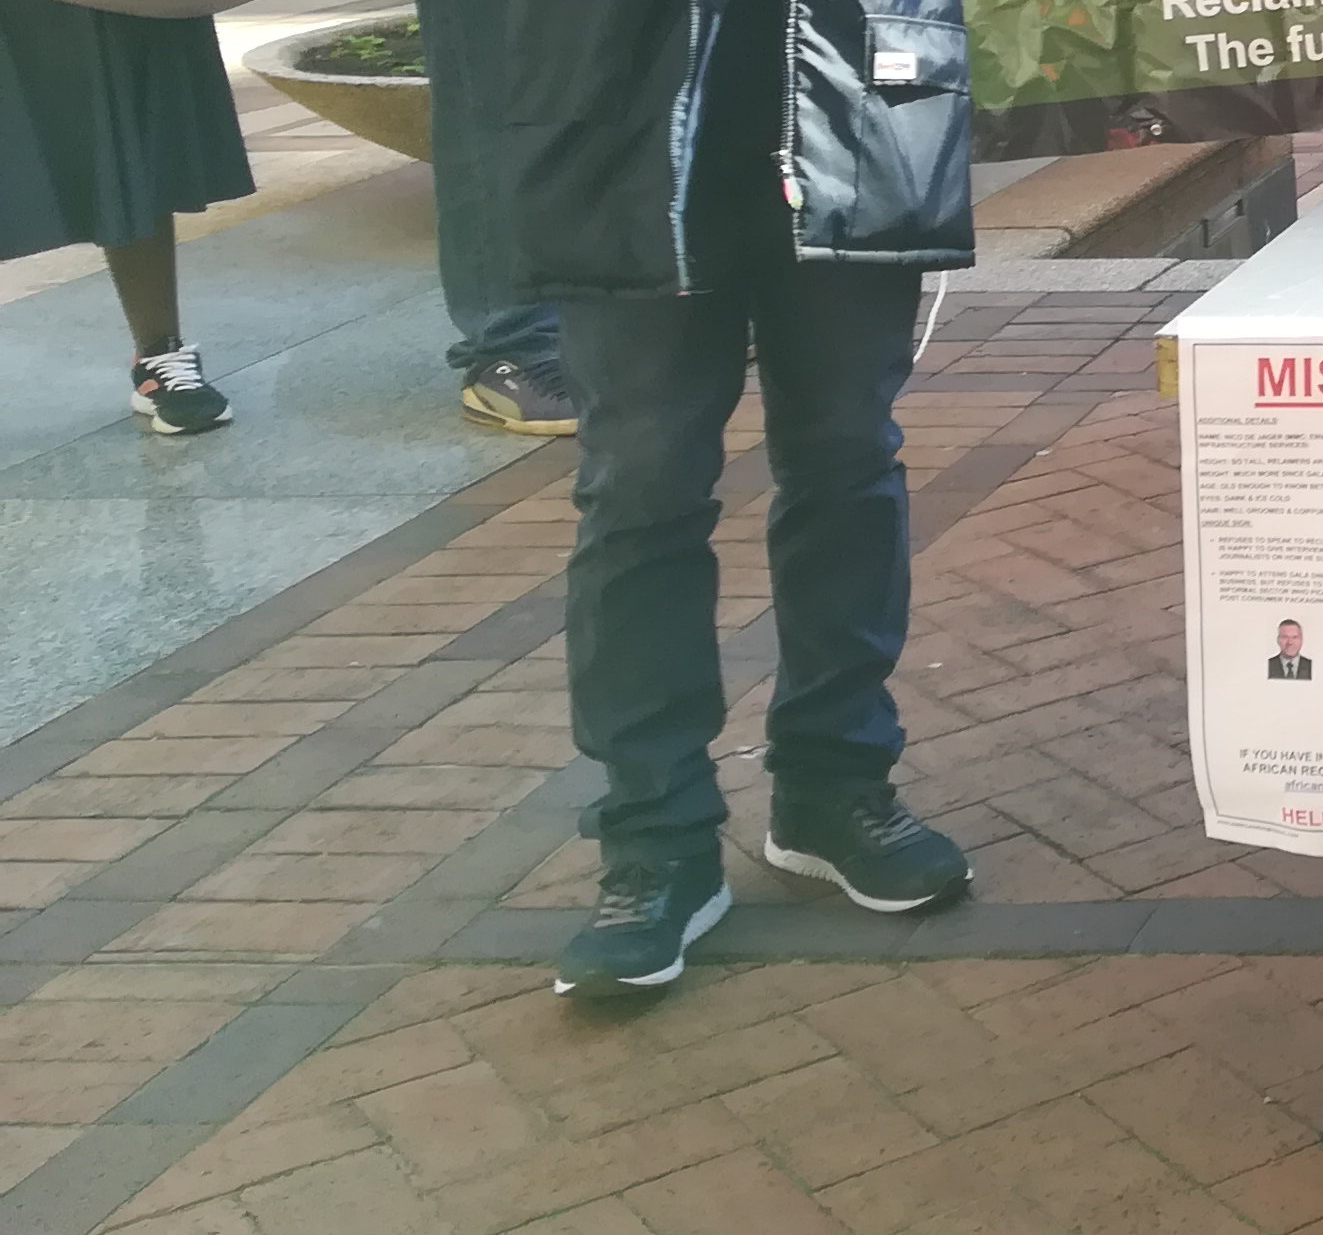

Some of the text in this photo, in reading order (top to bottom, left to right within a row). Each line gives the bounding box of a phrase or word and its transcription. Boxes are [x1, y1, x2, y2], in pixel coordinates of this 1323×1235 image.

[1186, 32, 1275, 72] The
[1240, 749, 1248, 758] IF
[1253, 750, 1277, 760] YOU
[1281, 751, 1311, 761] HAVE
[1243, 763, 1297, 775] AFRICAN
